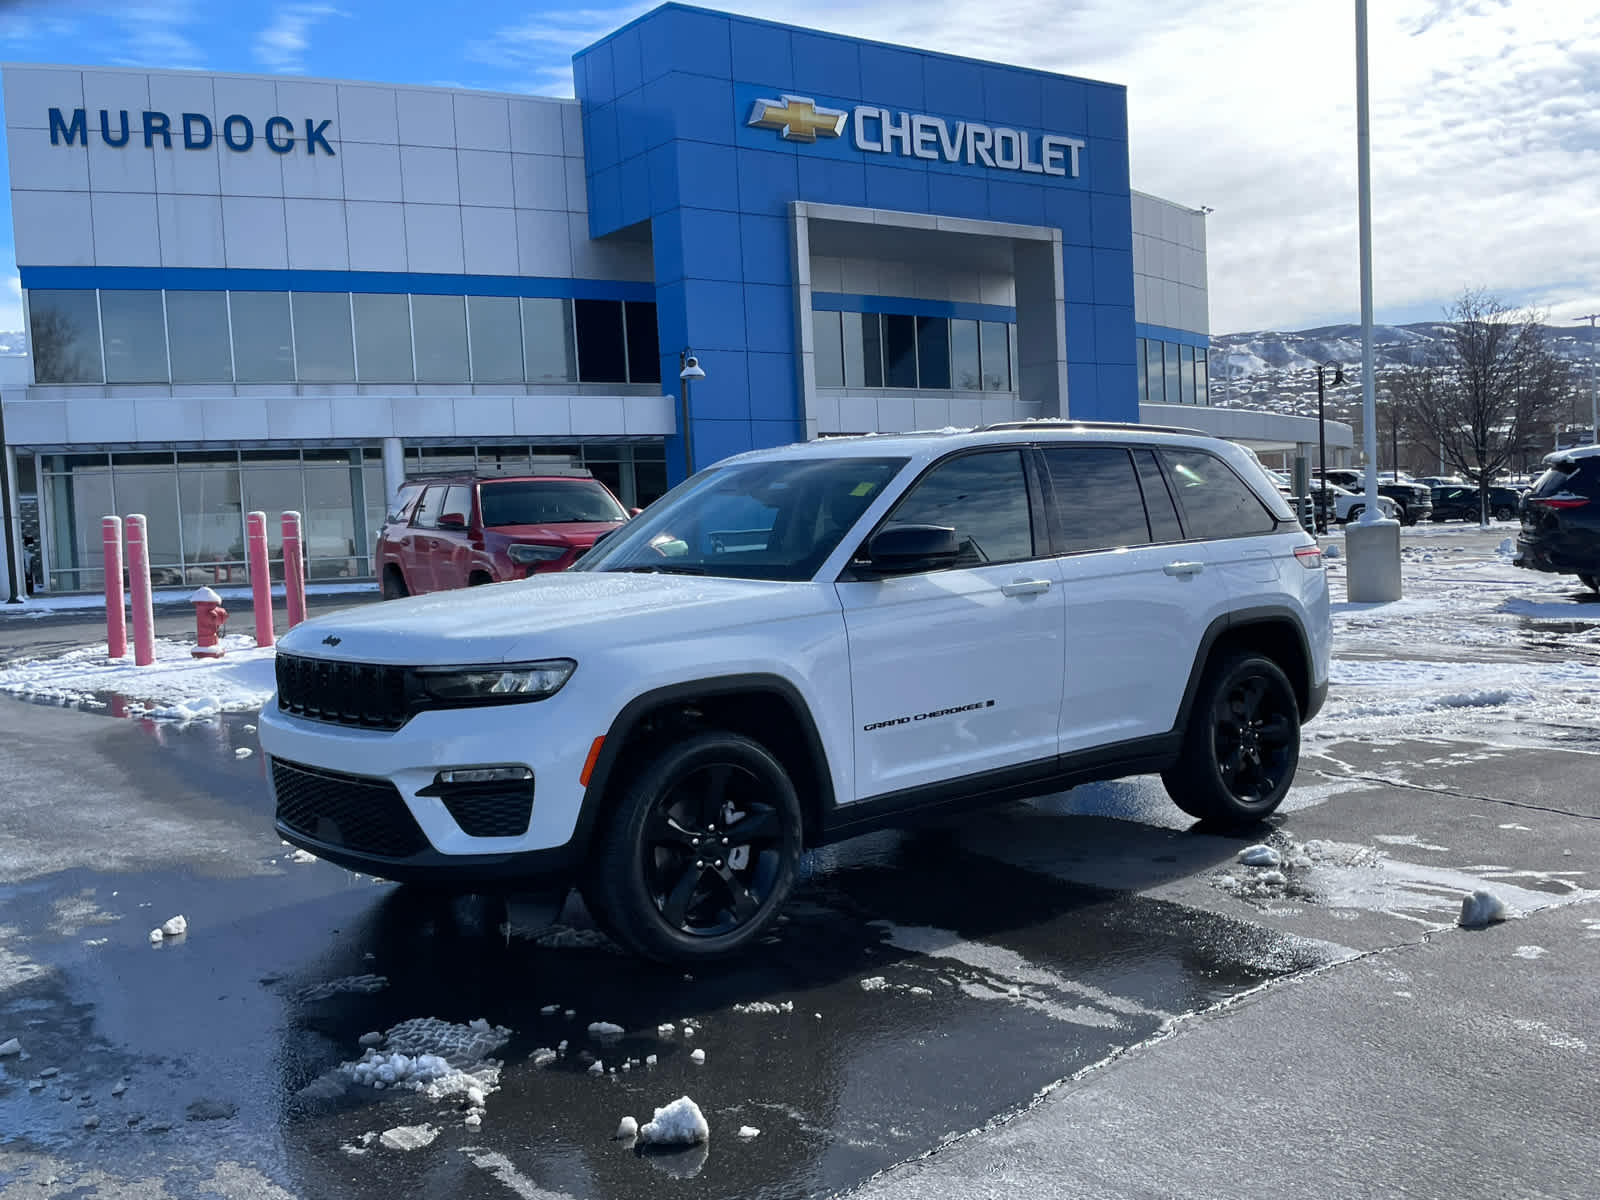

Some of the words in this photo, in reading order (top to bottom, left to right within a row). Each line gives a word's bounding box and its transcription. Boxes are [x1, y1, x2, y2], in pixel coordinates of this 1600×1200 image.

[48, 107, 336, 156] MURDOCK
[853, 105, 1086, 178] CHEVROLET
[863, 716, 911, 732] GRAND
[913, 701, 984, 721] CHEROKEE
